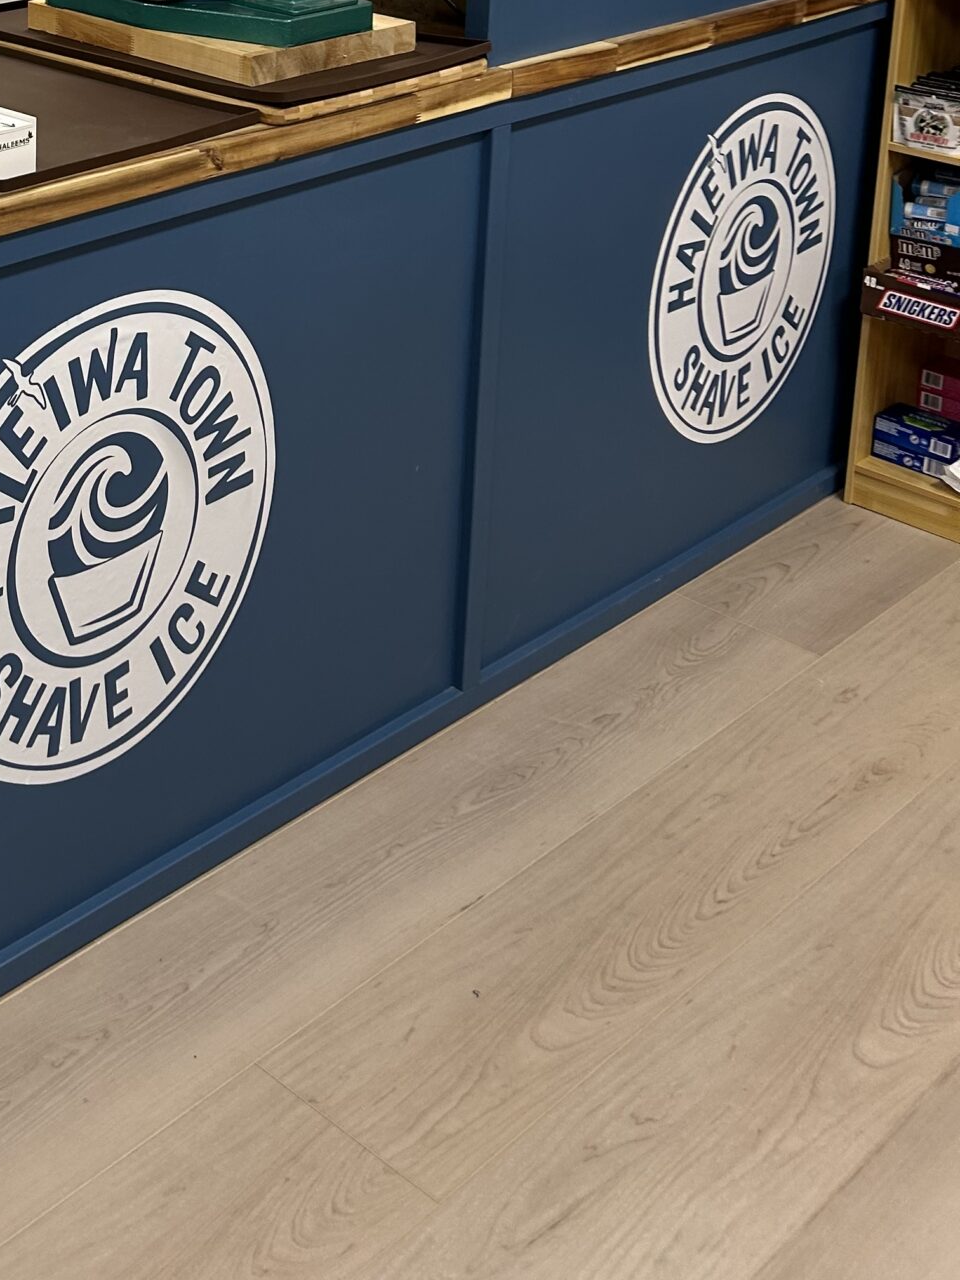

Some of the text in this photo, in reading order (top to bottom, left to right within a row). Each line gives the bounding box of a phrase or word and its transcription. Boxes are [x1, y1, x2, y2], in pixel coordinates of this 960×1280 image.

[785, 126, 823, 255] TOWN
[674, 295, 805, 425] SHAVE ICE
[883, 292, 957, 326] SNICKERS
[169, 330, 254, 505] TOWN
[148, 560, 231, 684] ICE
